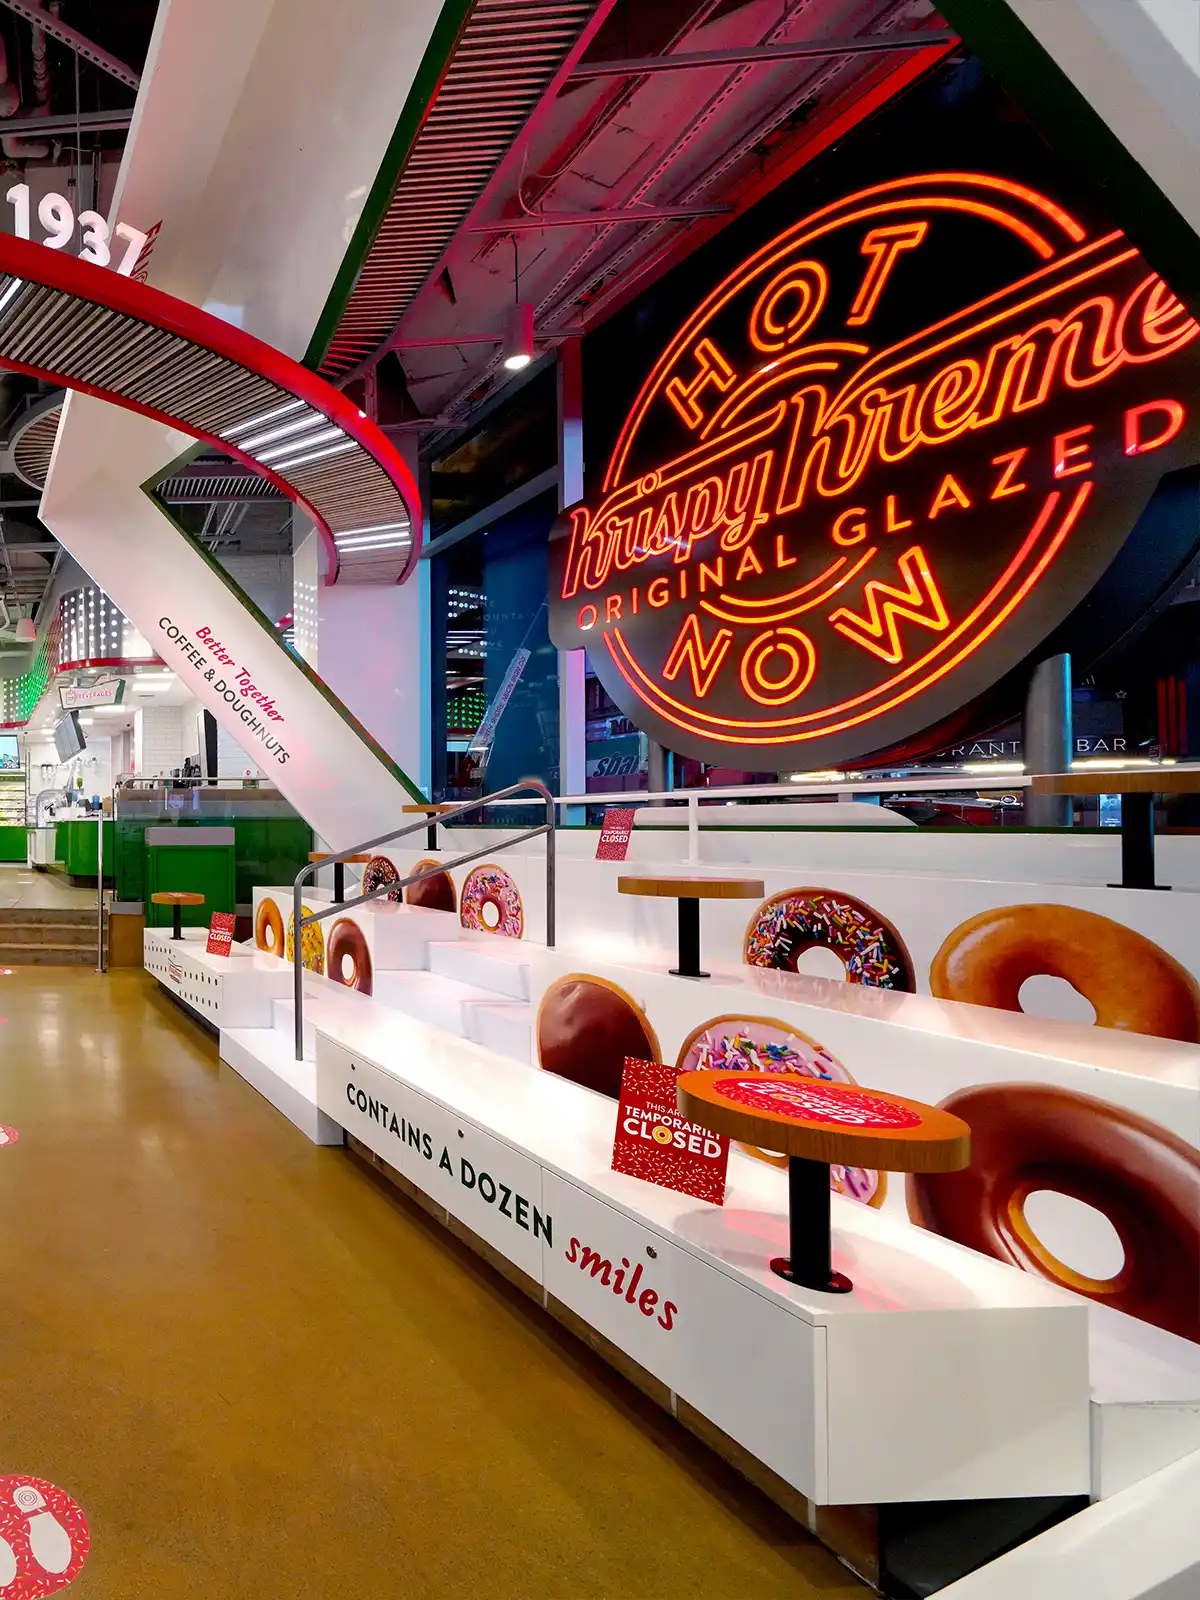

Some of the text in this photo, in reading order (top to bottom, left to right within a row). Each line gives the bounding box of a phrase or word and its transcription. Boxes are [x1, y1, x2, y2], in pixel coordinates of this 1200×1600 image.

[5, 182, 148, 277] 1937
[664, 221, 930, 432] HOT
[560, 255, 1200, 600] Krispy Kreme
[576, 399, 1187, 632] ORIGINAL GLAZED
[195, 626, 285, 723] Better Together
[663, 545, 950, 708] NOW
[158, 617, 291, 764] COFFEE & DOUGHNUTS
[936, 738, 1128, 757] RANT BAR
[601, 834, 629, 844] CLOSED
[209, 932, 232, 943] CLOSED
[623, 1118, 722, 1158] CLOSED
[645, 1101, 666, 1113] THIS
[345, 1081, 679, 1333] CONTAINS A DOZEN smiles
